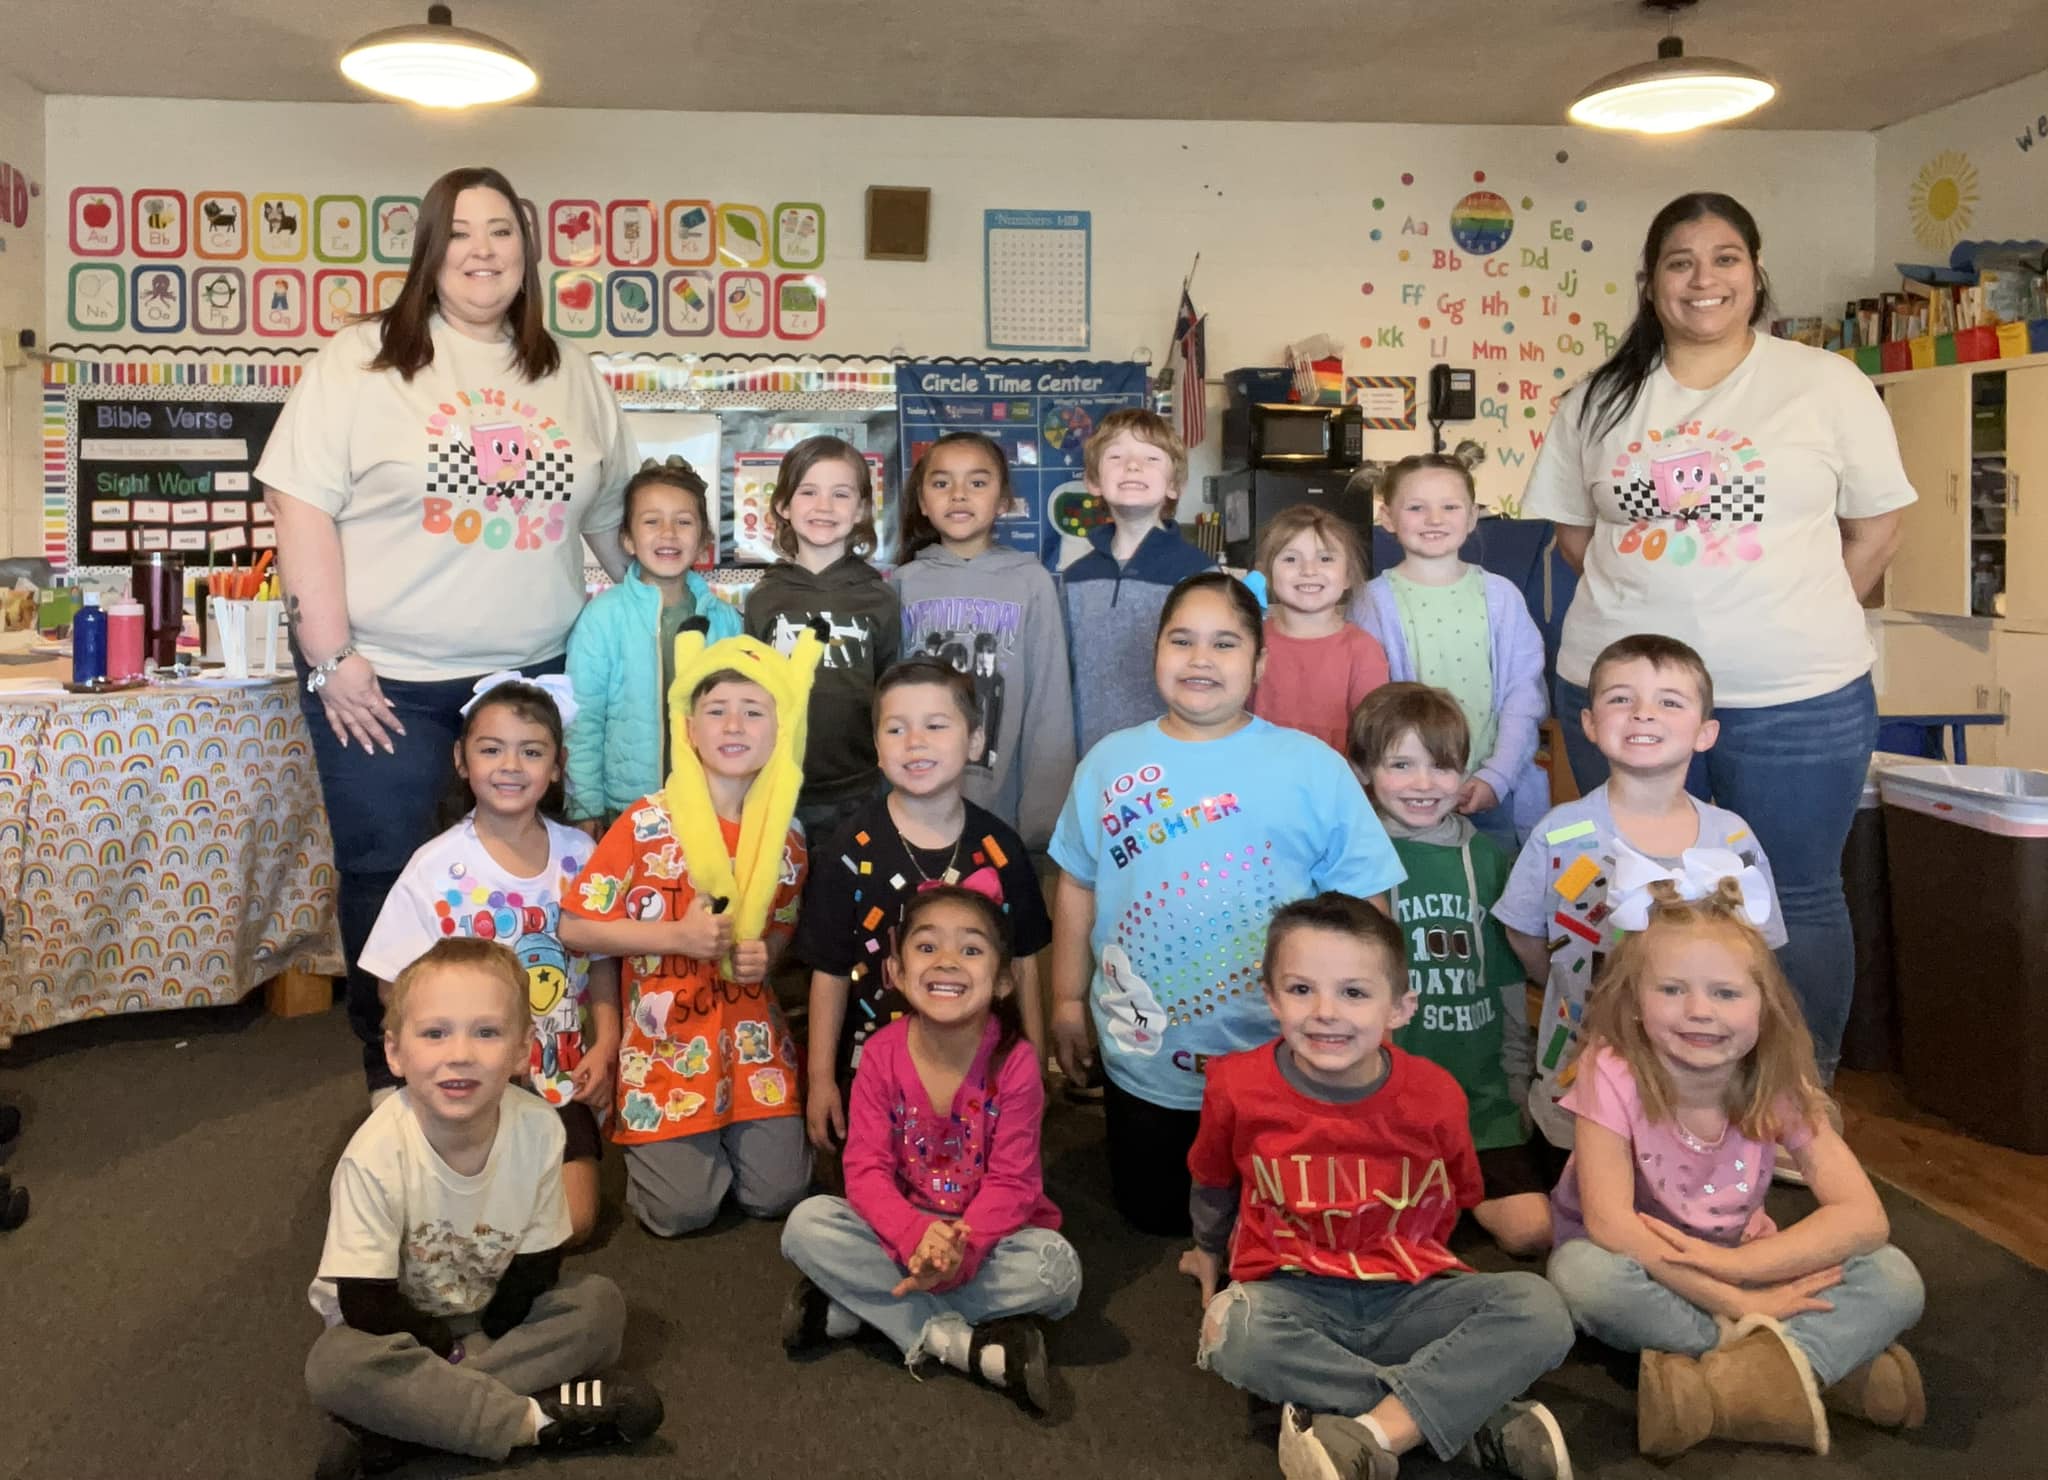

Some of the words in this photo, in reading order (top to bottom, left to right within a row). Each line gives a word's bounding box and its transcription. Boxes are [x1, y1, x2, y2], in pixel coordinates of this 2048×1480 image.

[1401, 215, 1428, 236] Aa
[1550, 220, 1574, 242] Ee
[87, 230, 108, 244] Aa
[149, 232, 170, 246] Bb
[211, 233, 233, 247] Cc
[1432, 249, 1461, 271] Bb
[1484, 258, 1509, 278] Cc
[1520, 247, 1549, 270] Dd
[1402, 283, 1426, 305] Ff
[1558, 269, 1578, 297] Jj
[86, 304, 108, 319] Nn
[148, 306, 170, 320] Oo
[1437, 293, 1466, 326] Gg
[1481, 290, 1508, 316] Hh
[1377, 325, 1404, 348] Kk
[1557, 334, 1584, 356] Oo
[1472, 340, 1507, 360] Mm
[1519, 342, 1545, 362] Nn
[921, 373, 979, 392] Circle
[984, 373, 1032, 392] Time
[1037, 374, 1103, 392] Center
[1519, 379, 1542, 400] Rr
[97, 406, 151, 429] Bible
[167, 406, 233, 429] Verse
[1480, 397, 1508, 428] Qq
[97, 473, 149, 496] Sight
[158, 471, 211, 496] Word
[422, 496, 567, 551] BOOKS
[1102, 764, 1163, 811] 100
[1102, 787, 1174, 837] DAYS
[1109, 793, 1241, 870] BRIGHTER
[1251, 1153, 1451, 1211] NINJA
